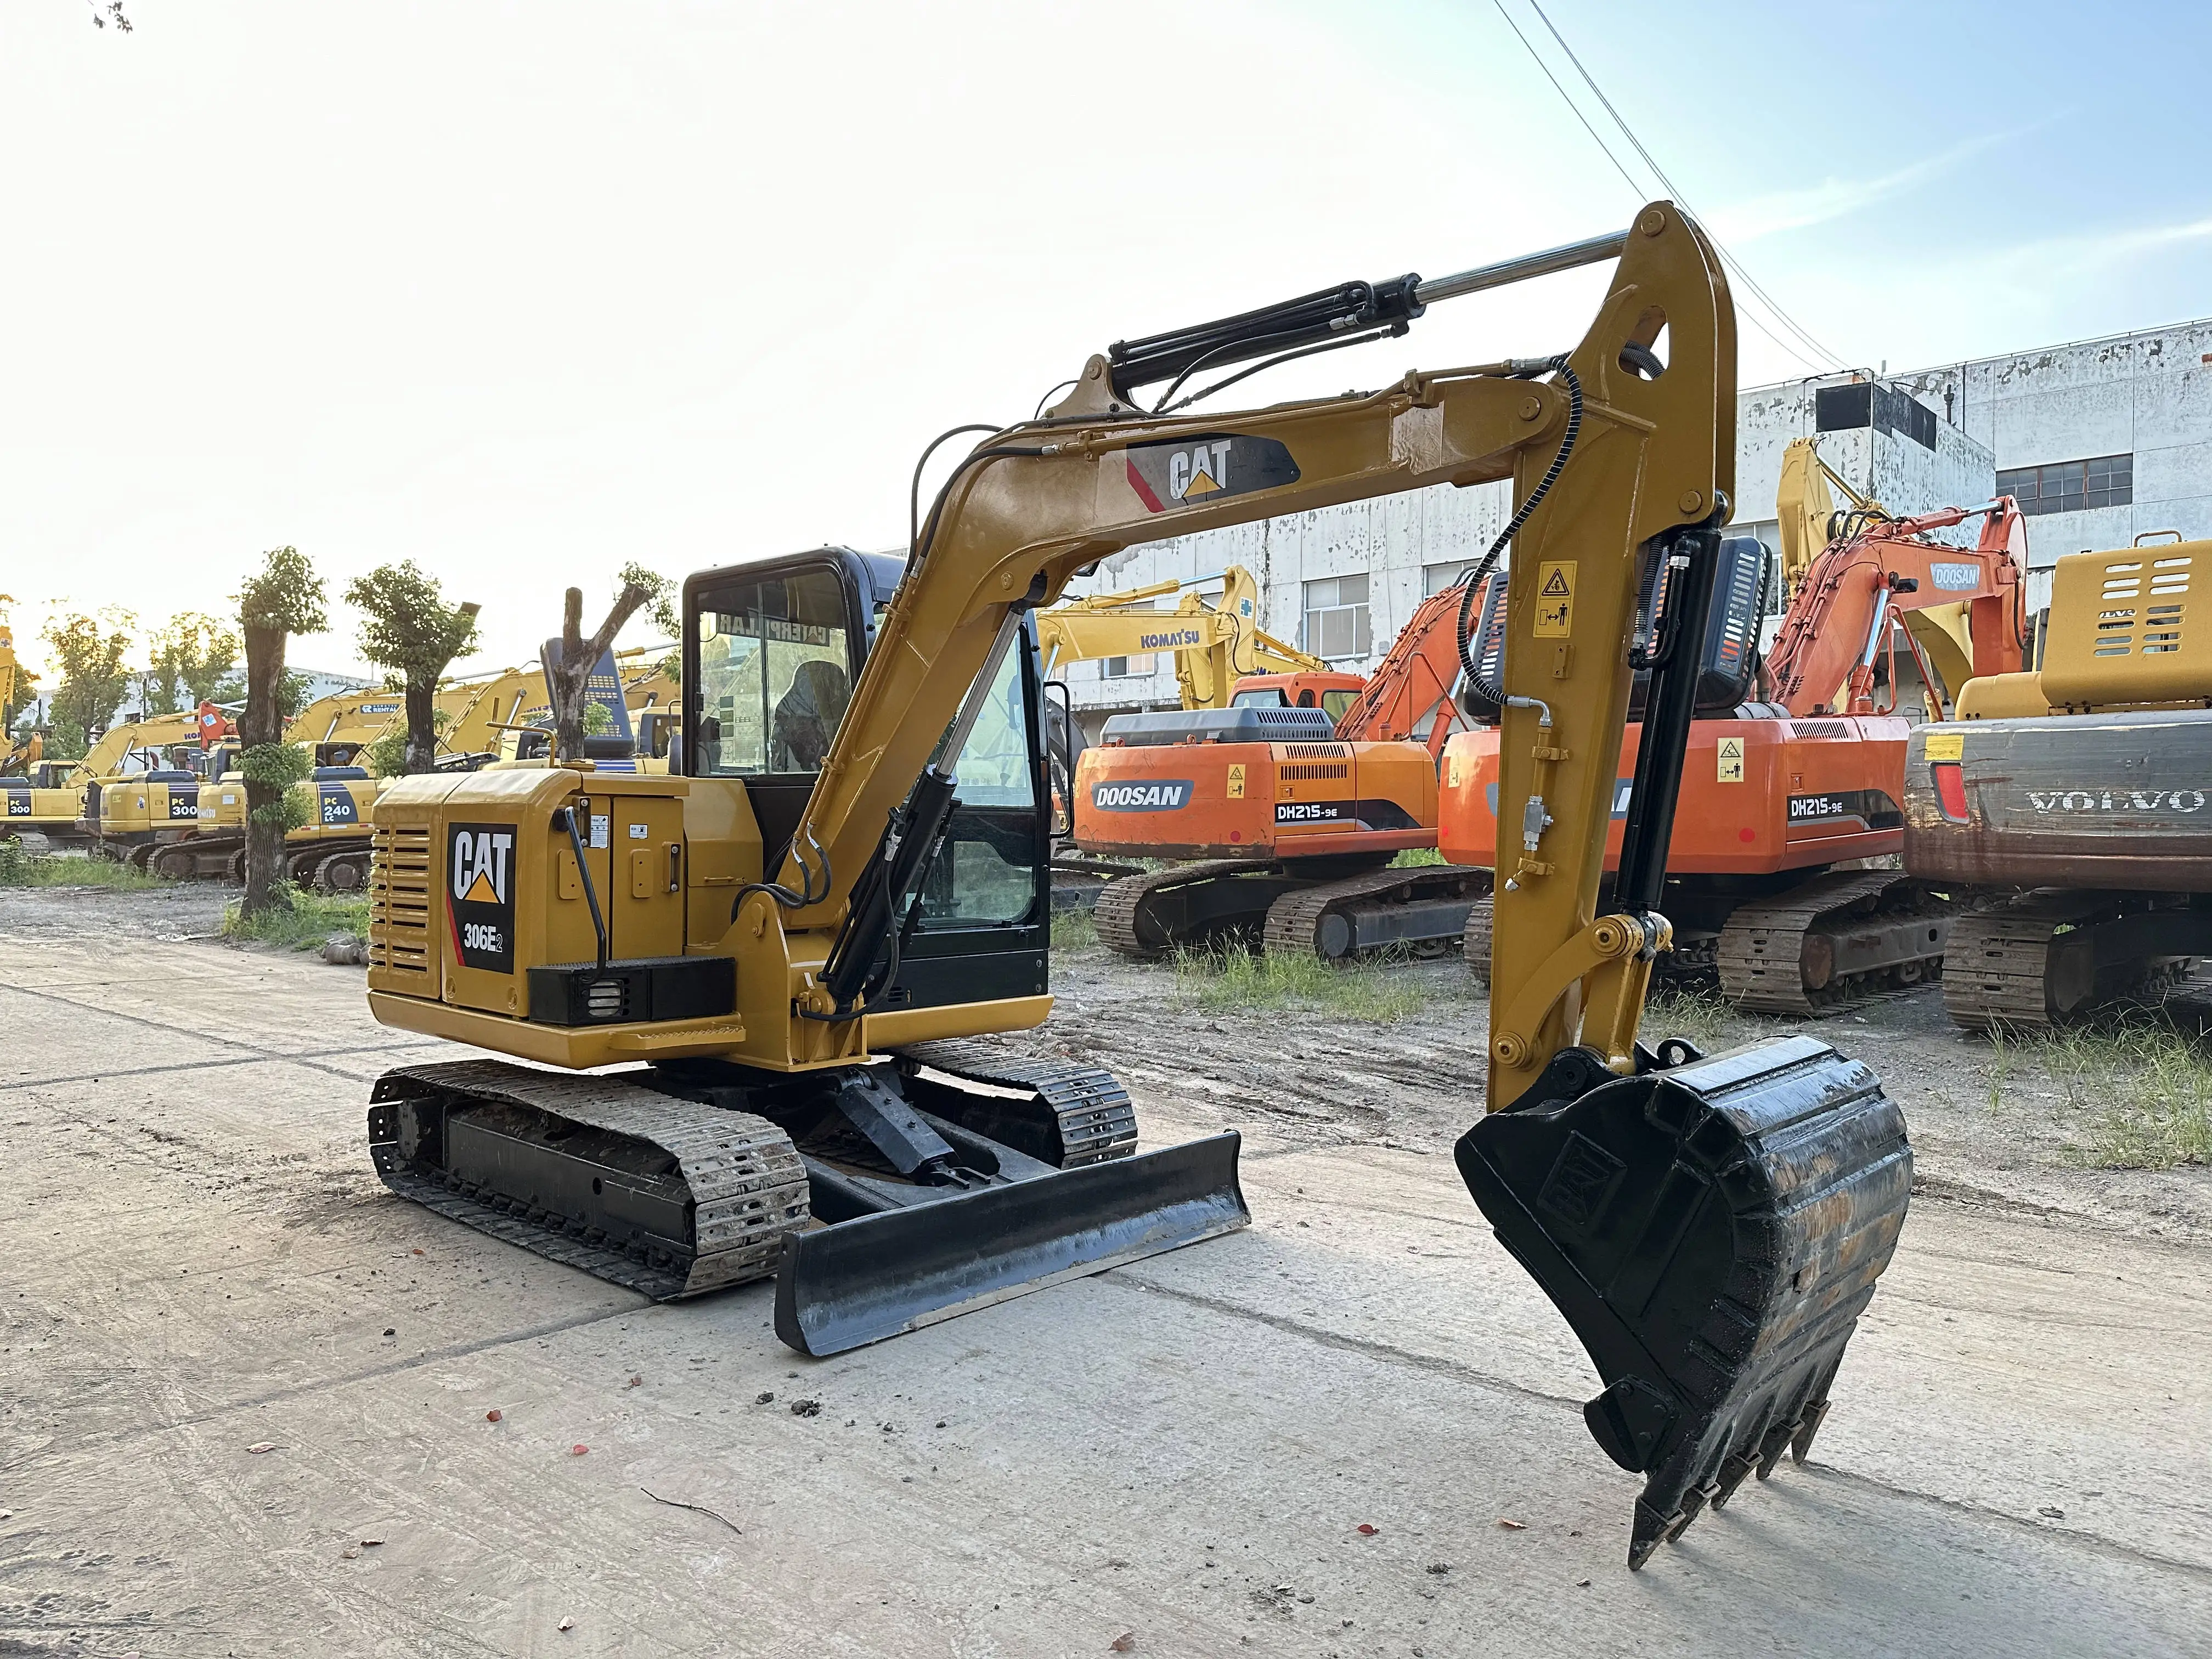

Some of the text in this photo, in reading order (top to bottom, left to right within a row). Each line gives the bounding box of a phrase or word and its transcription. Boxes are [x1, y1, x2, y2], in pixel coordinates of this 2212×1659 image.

[1170, 439, 1231, 500] CAT
[1936, 568, 1976, 584] DOOSAN
[1141, 629, 1199, 649] KOMATSU
[1096, 786, 1183, 806] DOOSAN
[2024, 790, 2205, 814] VOLVO
[172, 805, 198, 816] 300
[324, 805, 350, 816] 240
[1278, 805, 1338, 820] DH215-9E
[1791, 797, 1842, 816] DH215-9E
[454, 831, 512, 904] CAT
[464, 923, 503, 953] 306E2
